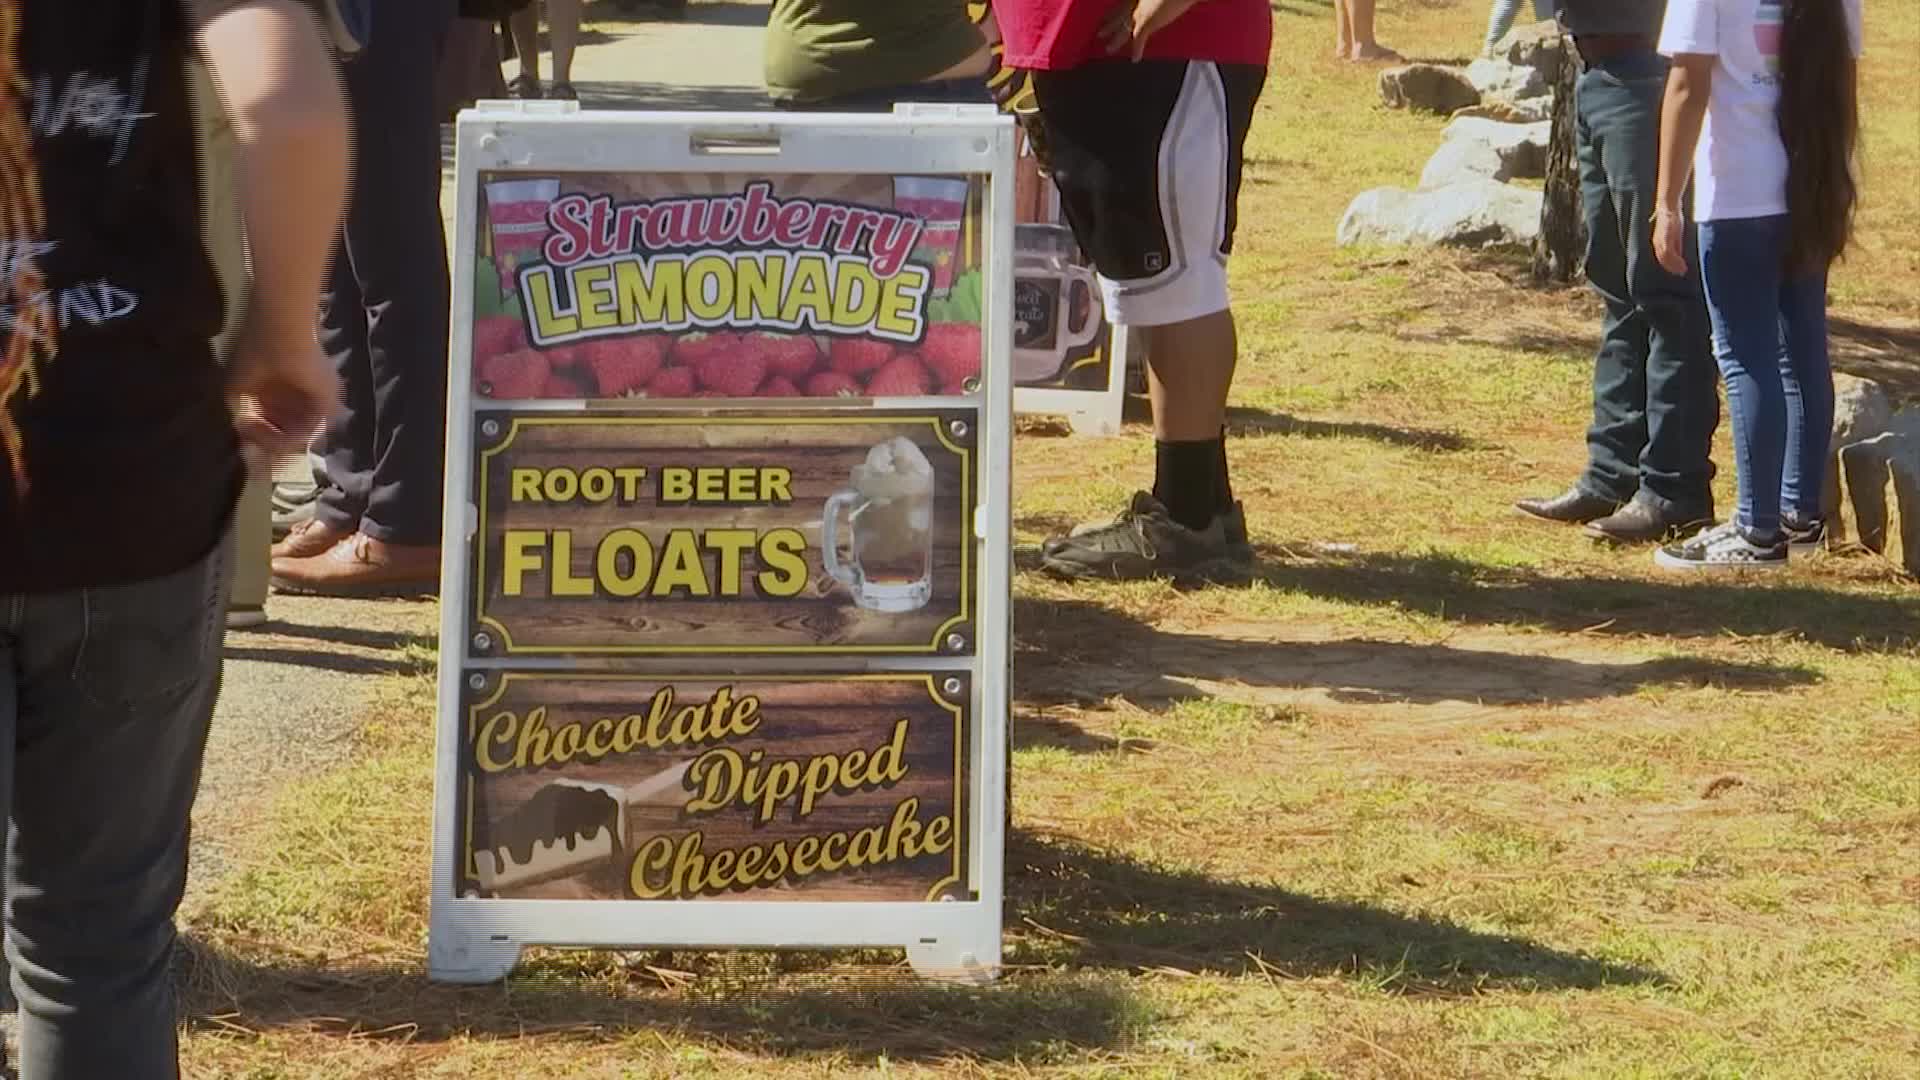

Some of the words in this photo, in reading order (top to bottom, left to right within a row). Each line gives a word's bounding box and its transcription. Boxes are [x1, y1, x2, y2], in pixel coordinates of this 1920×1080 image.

[544, 183, 924, 277] Strawberry
[523, 251, 928, 342] LEMONADE
[511, 467, 647, 502] ROOT
[662, 467, 793, 502] BEER
[503, 529, 809, 598] FLOATS
[476, 687, 761, 773] Chocolate
[686, 721, 909, 821] Dipped
[631, 799, 953, 898] Cheesecake
